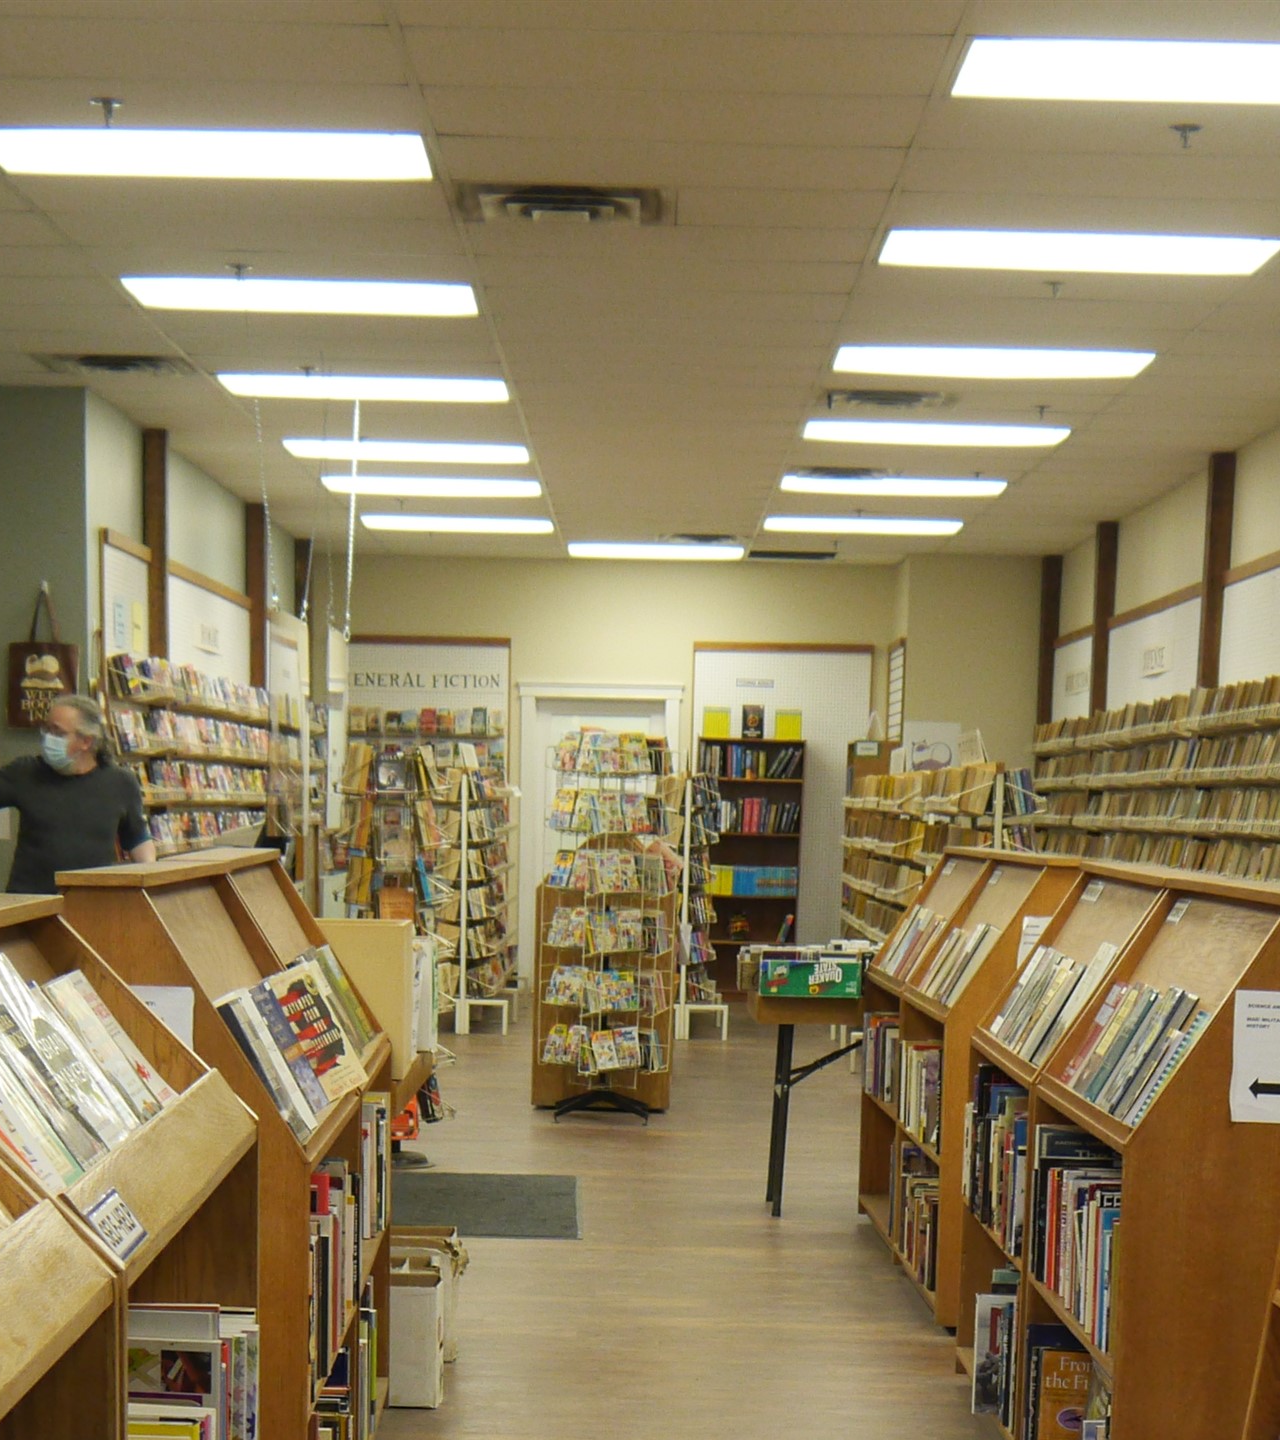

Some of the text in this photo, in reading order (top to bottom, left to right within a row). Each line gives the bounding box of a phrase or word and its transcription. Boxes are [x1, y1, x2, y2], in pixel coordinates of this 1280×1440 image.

[354, 672, 500, 688] ENERAL FICTION
[808, 967, 843, 985] QUAKER
[1045, 1372, 1068, 1388] the
